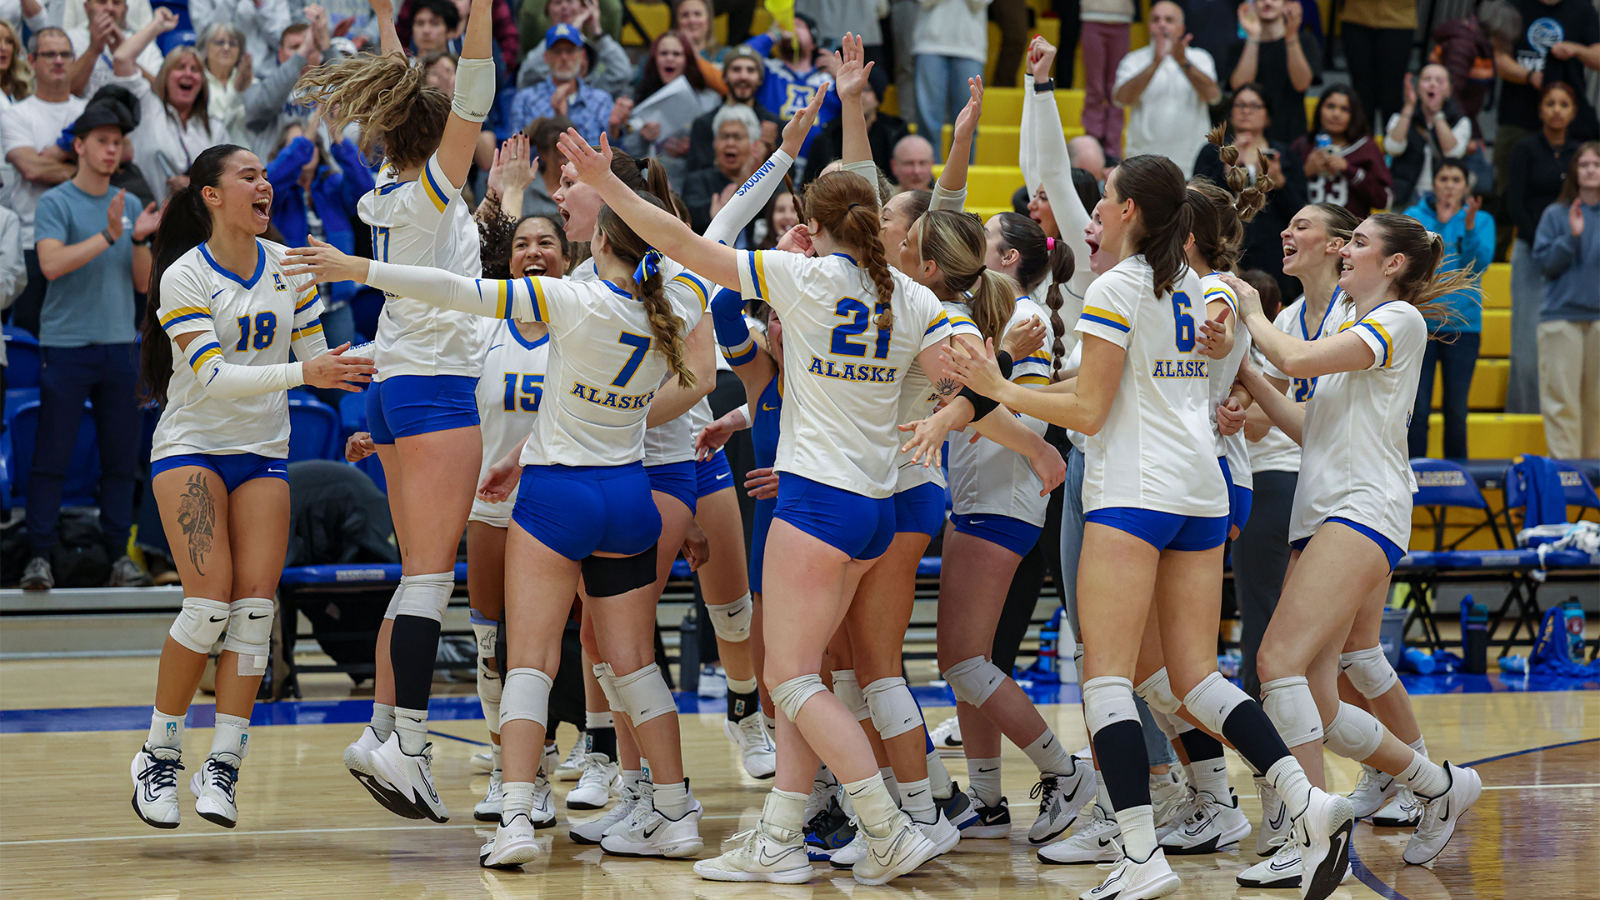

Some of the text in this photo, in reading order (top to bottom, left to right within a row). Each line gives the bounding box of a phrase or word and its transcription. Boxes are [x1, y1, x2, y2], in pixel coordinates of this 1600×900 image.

[780, 84, 819, 126] A
[736, 160, 775, 197] NANOOKS
[235, 310, 277, 352] 18
[831, 296, 893, 360] 21
[1171, 290, 1197, 353] 6
[609, 330, 652, 389] 7
[808, 355, 899, 383] ALASKA
[1152, 359, 1209, 379] ALASK
[503, 371, 545, 413] 15
